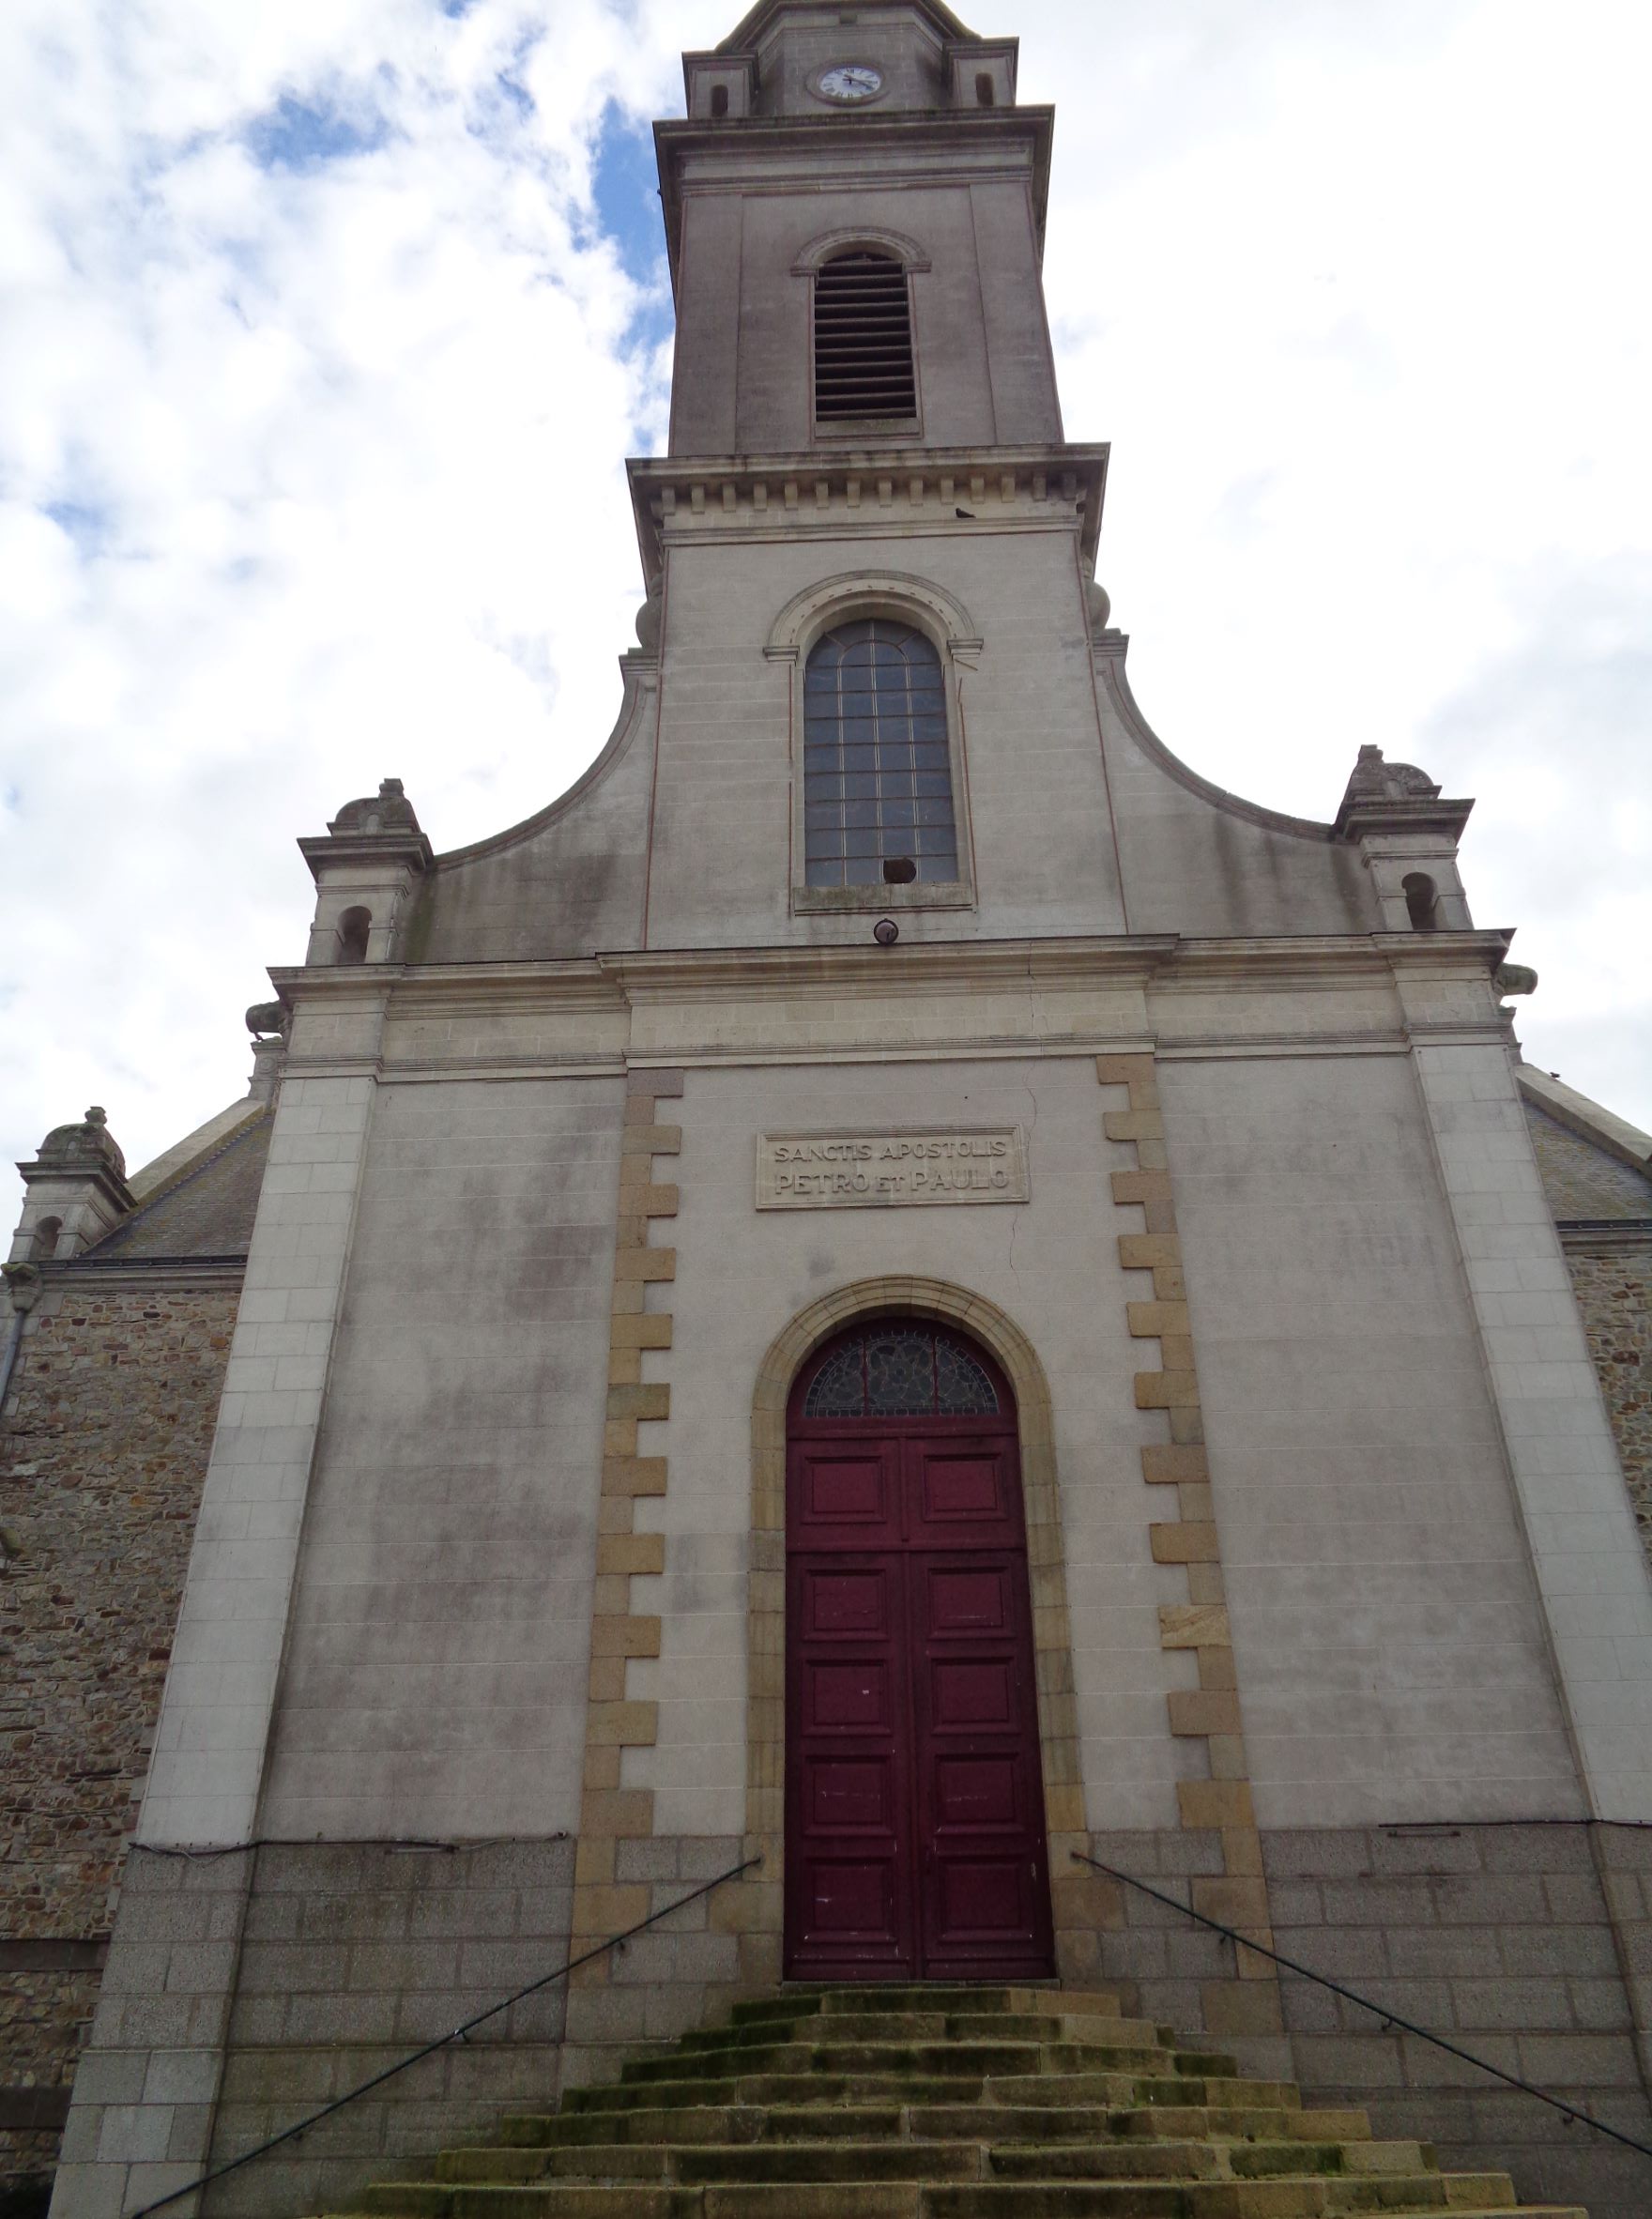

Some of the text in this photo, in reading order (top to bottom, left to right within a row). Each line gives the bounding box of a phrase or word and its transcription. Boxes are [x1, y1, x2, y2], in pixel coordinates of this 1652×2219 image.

[774, 1141, 1006, 1163] SANCTIS APOSTOLIS
[774, 1171, 1009, 1194] PETRO ET PAULO
